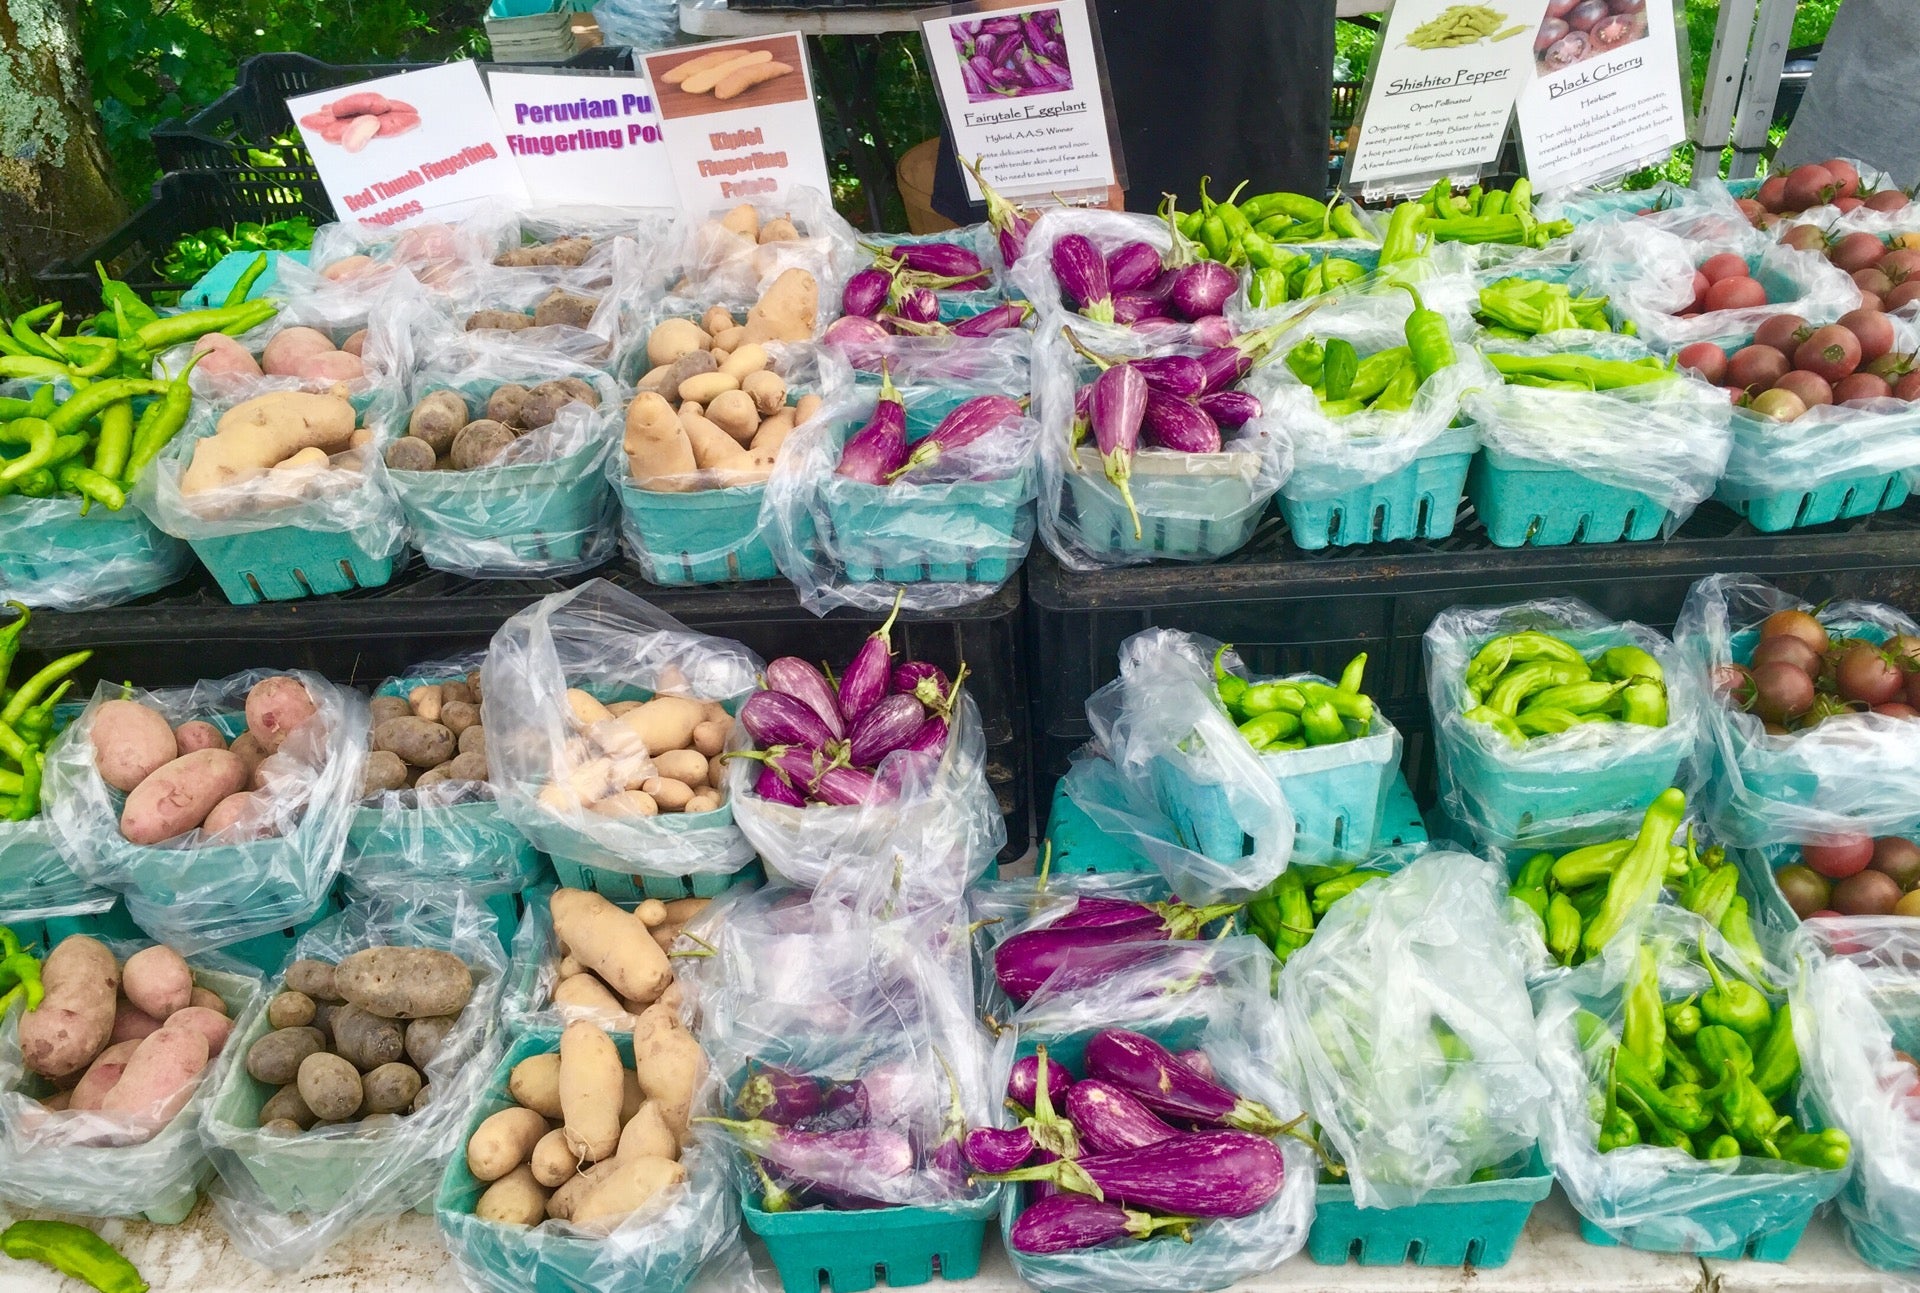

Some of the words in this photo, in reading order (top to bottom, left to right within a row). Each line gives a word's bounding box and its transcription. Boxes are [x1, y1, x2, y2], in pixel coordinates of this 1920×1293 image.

[1385, 74, 1451, 96] Shishito
[1454, 69, 1510, 85] Pepper
[1549, 72, 1590, 99] Black
[1593, 56, 1643, 81] Cherry
[515, 98, 618, 125] Peruvian
[1410, 103, 1433, 112] Open
[1435, 95, 1472, 108] Pollinated
[1581, 91, 1616, 109] Heirloom
[964, 108, 1021, 126] Fairytale
[1024, 101, 1087, 118] Eggplant
[1536, 133, 1554, 143] The
[1556, 125, 1572, 135] only
[1573, 118, 1590, 129] truly
[1591, 110, 1611, 122] black
[1613, 103, 1636, 115] cherry
[709, 127, 764, 151] Kipfel
[986, 132, 1015, 143] Hybrid,
[1046, 127, 1074, 135] Winner
[1368, 123, 1411, 135] Originating
[1387, 136, 1402, 146] just
[1403, 133, 1424, 142] super
[1447, 125, 1473, 135] Blister
[1474, 121, 1491, 130] them
[1570, 147, 1582, 157] full
[1583, 140, 1609, 153] tomato
[1610, 131, 1635, 143] flavors
[1636, 124, 1651, 133] that
[1653, 116, 1673, 127] burst
[1578, 127, 1610, 142] delicious
[1611, 118, 1626, 129] with
[506, 128, 624, 156] Fingerling
[1058, 141, 1072, 149] and
[1382, 149, 1396, 158] pan
[1397, 145, 1411, 153] and
[1413, 141, 1432, 151] finish
[697, 151, 788, 178] Fingerling
[994, 161, 1008, 170] with
[1009, 159, 1032, 168] tender
[1034, 157, 1048, 165] skin
[1049, 155, 1062, 163] and
[1009, 172, 1026, 180] need
[1037, 168, 1053, 176] soak
[1359, 163, 1368, 171] A
[343, 188, 378, 212] Red
[370, 170, 425, 201] Thumb
[419, 142, 498, 182] Fingerling
